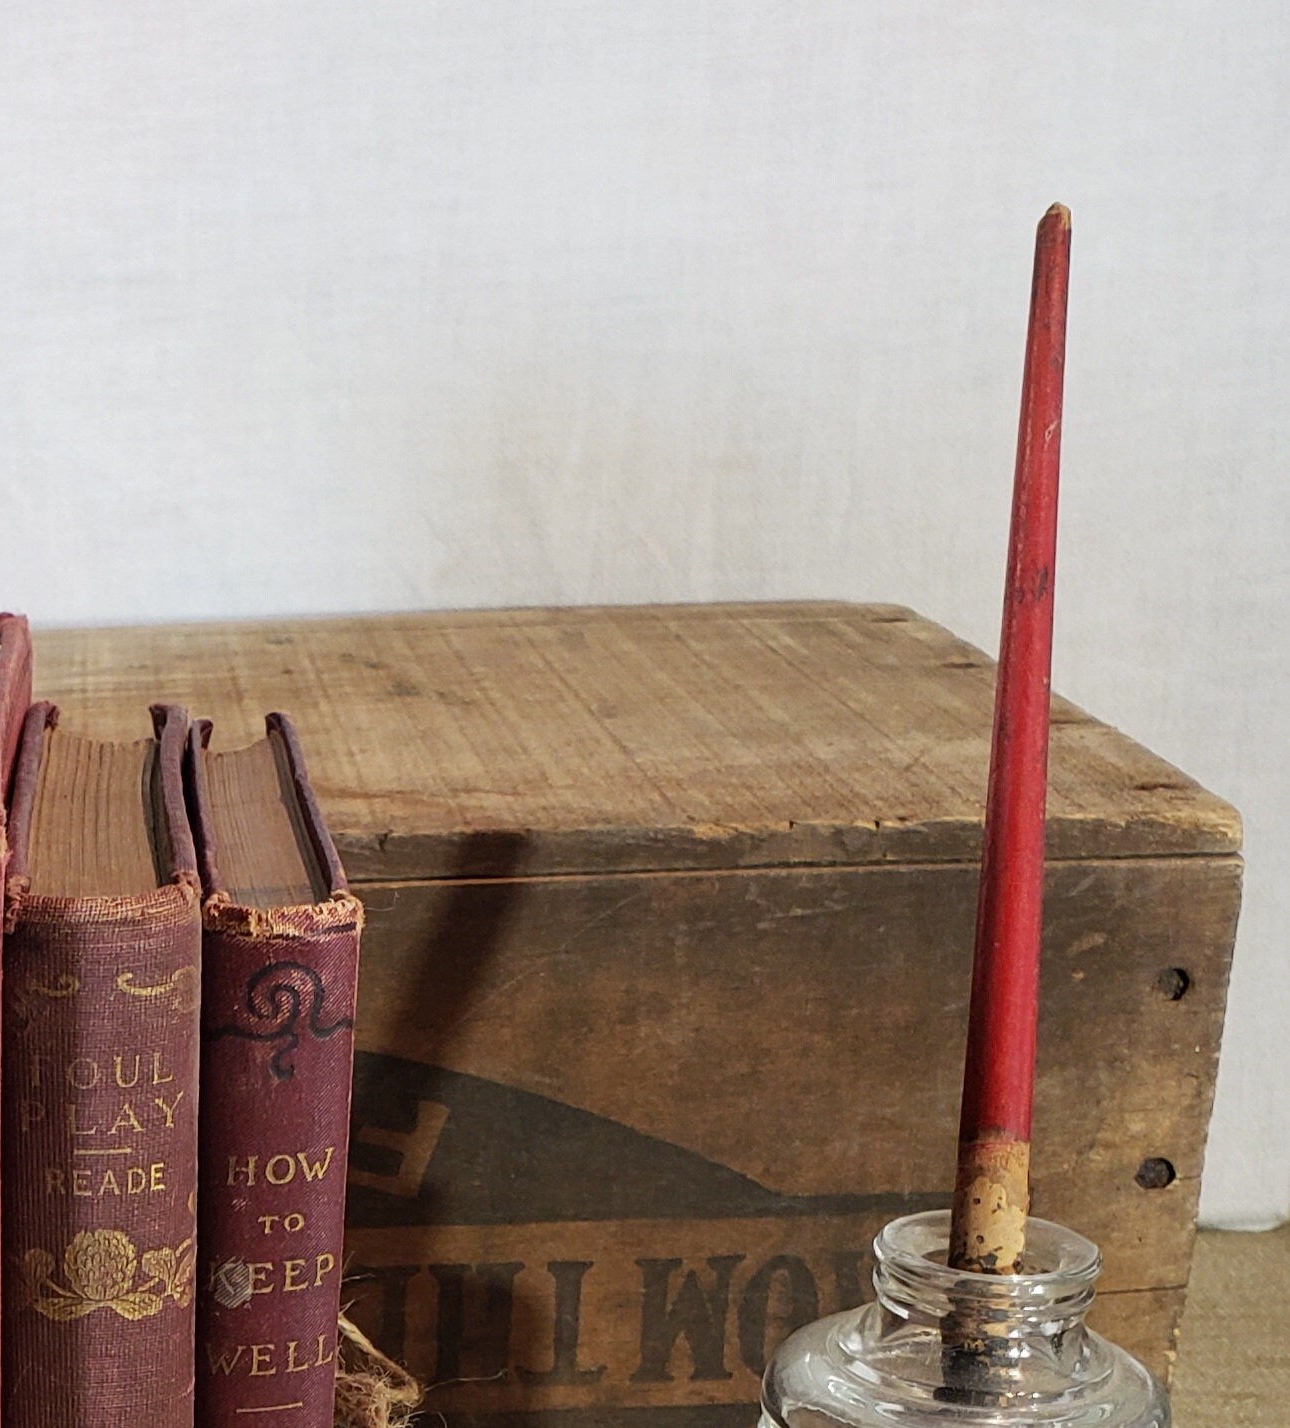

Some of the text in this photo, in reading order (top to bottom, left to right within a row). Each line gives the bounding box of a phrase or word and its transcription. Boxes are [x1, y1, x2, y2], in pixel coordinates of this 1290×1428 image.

[45, 1162, 167, 1198] READE
[226, 1145, 337, 1187] HOW
[257, 1212, 306, 1236] TO
[205, 1333, 335, 1377] WELL
